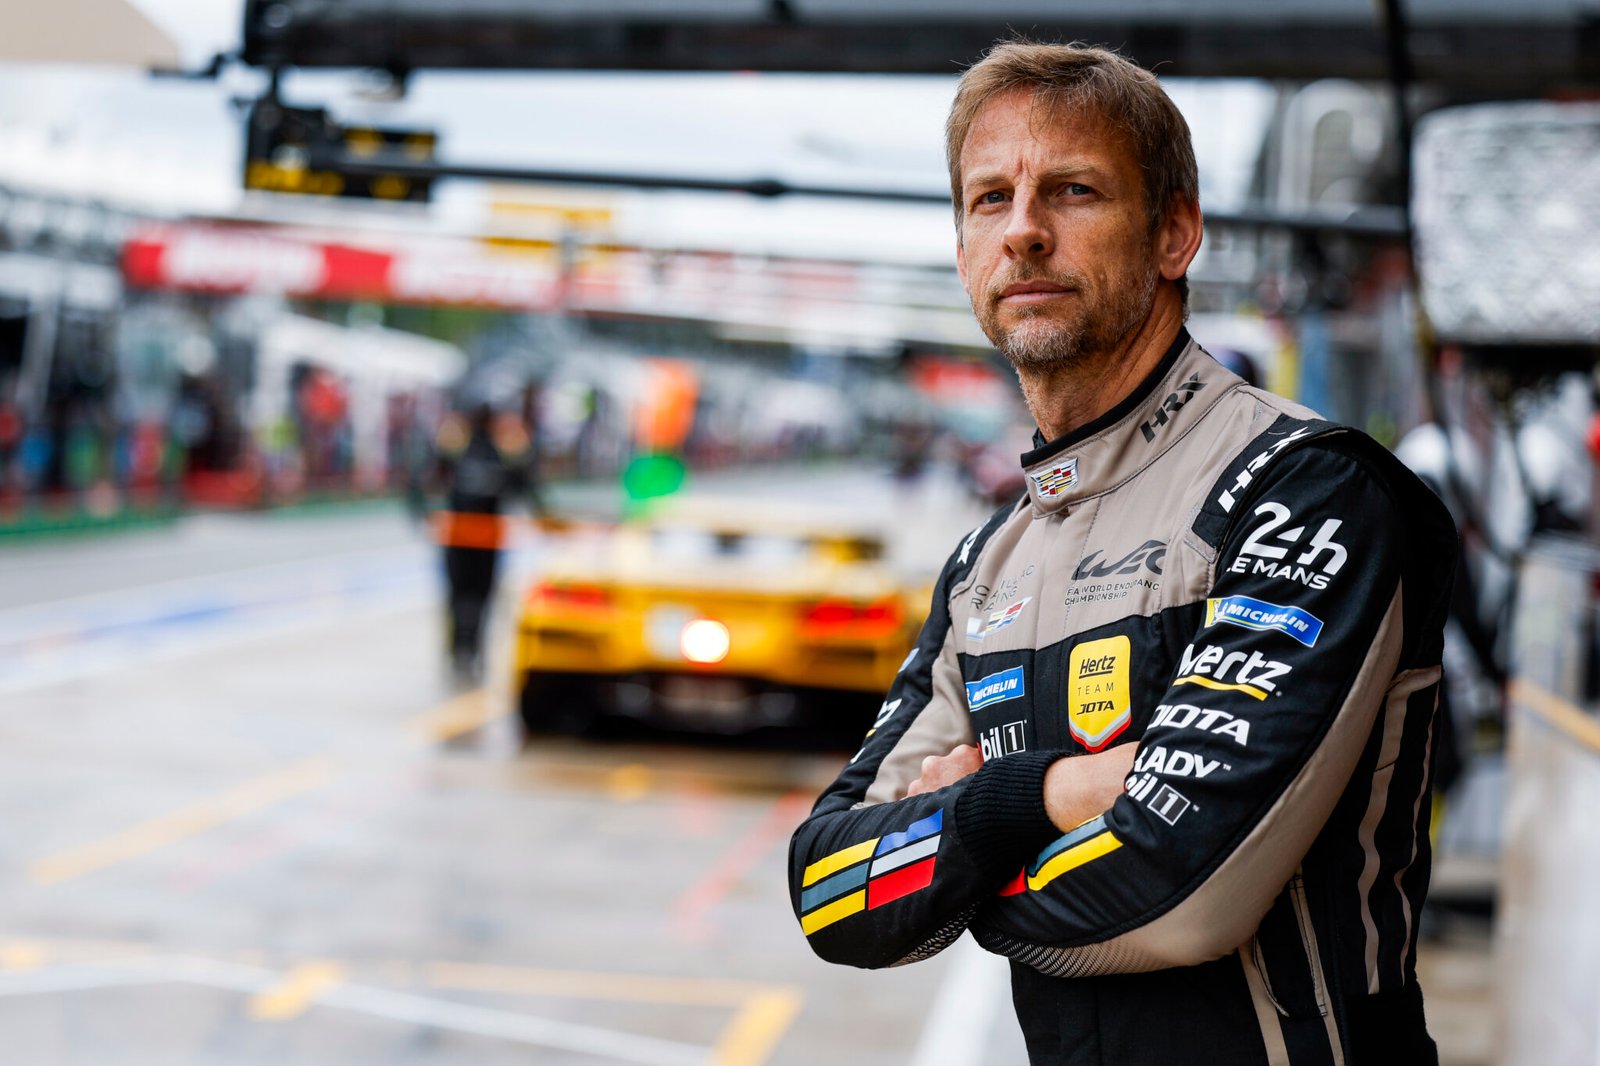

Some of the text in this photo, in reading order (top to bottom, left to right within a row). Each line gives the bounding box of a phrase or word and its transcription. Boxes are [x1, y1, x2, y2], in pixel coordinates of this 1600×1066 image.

[1140, 371, 1208, 444] HRX
[1217, 426, 1314, 513] HRX
[1081, 584, 1113, 594] WORLD
[1226, 556, 1332, 590] E MANS
[1064, 591, 1128, 606] CHAMPIONSHIP
[1226, 603, 1310, 633] MICHELIN
[1079, 655, 1117, 675] Hertz
[1177, 643, 1293, 693] Hertz
[1077, 682, 1115, 697] TEAM
[1076, 700, 1115, 716] JOTA
[1147, 704, 1251, 747] JOTA
[977, 726, 1004, 763] bil
[1133, 745, 1221, 779] RADY
